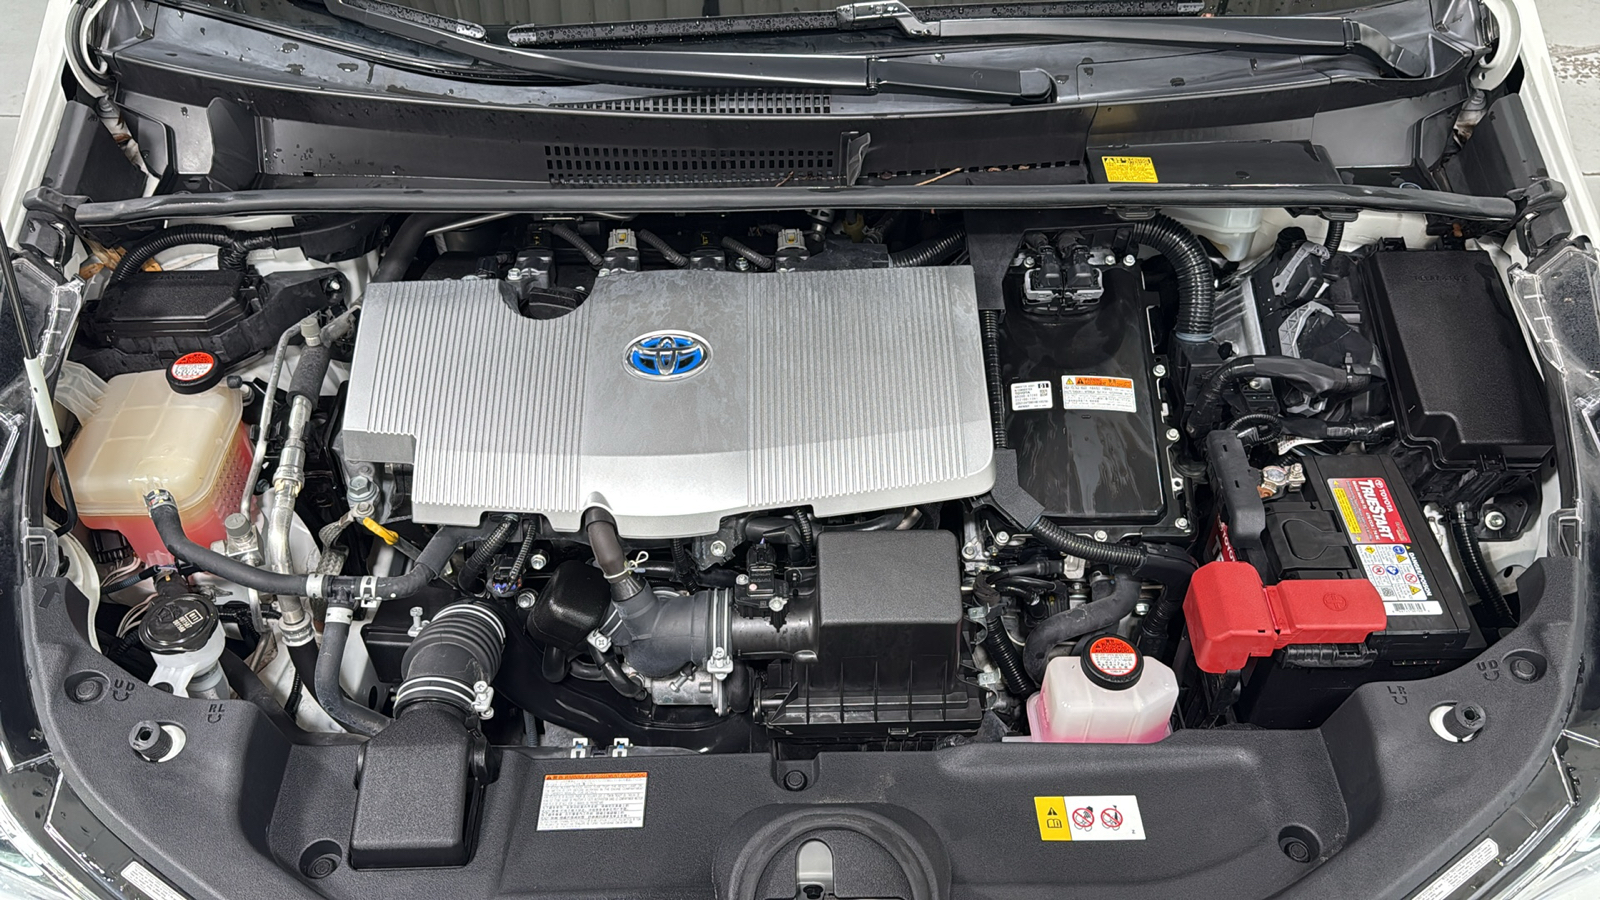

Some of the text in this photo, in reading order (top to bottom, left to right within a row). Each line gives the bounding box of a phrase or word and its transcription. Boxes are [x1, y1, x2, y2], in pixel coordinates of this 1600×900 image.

[1358, 479, 1395, 540] TRUESTART
[1379, 489, 1394, 512] TOYOTA
[208, 703, 225, 713] RL
